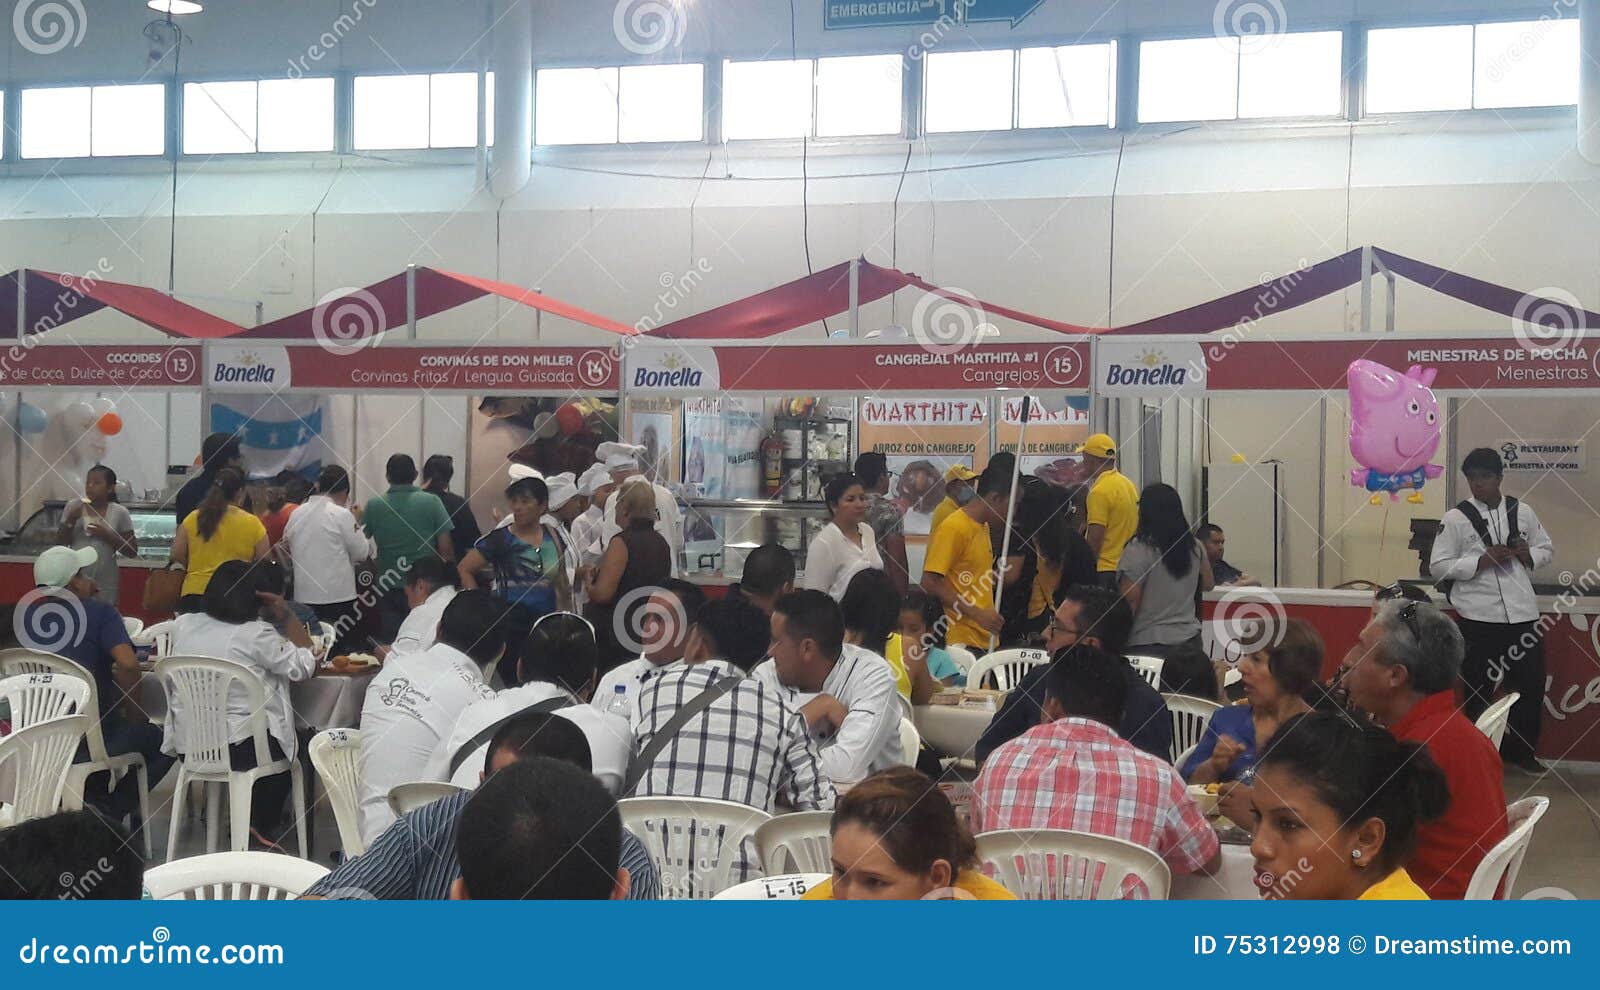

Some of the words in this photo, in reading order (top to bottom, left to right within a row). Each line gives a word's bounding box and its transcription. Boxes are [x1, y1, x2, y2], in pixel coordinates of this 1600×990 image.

[831, 1, 921, 18] EMERGENCIA
[107, 353, 161, 363] COCOIDES
[420, 355, 480, 366] CORVINAS
[483, 355, 499, 366] DE
[502, 355, 529, 366] DON
[533, 355, 574, 366] MILLER
[875, 353, 950, 366] CANGREJAL
[953, 352, 1021, 364] MARTHITA
[1024, 352, 1039, 362] #1
[1407, 350, 1499, 362] MENESTRAS
[1504, 349, 1525, 361] DE
[1530, 347, 1588, 361] POCHA
[173, 358, 188, 372] 13
[1053, 357, 1073, 374] 15
[1497, 365, 1589, 380] Menestras
[12, 368, 27, 380] de
[71, 367, 104, 379] Dulce
[110, 367, 124, 379] de
[130, 367, 162, 379] Coco
[214, 363, 275, 383] Bonella
[351, 368, 408, 383] Corvinas
[414, 369, 449, 383] Fritos
[464, 369, 512, 386] Lengua
[519, 368, 574, 383] Guisada
[634, 367, 702, 388] Bonella
[963, 367, 1040, 385] Cangrejos
[1107, 364, 1186, 386] Bonella
[866, 401, 984, 421] MARTHITA
[873, 444, 902, 454] ARROZ
[905, 444, 924, 454] CON
[926, 444, 976, 454] CANGREJO
[1028, 442, 1038, 453] DE
[1520, 445, 1579, 454] RESTAURANT
